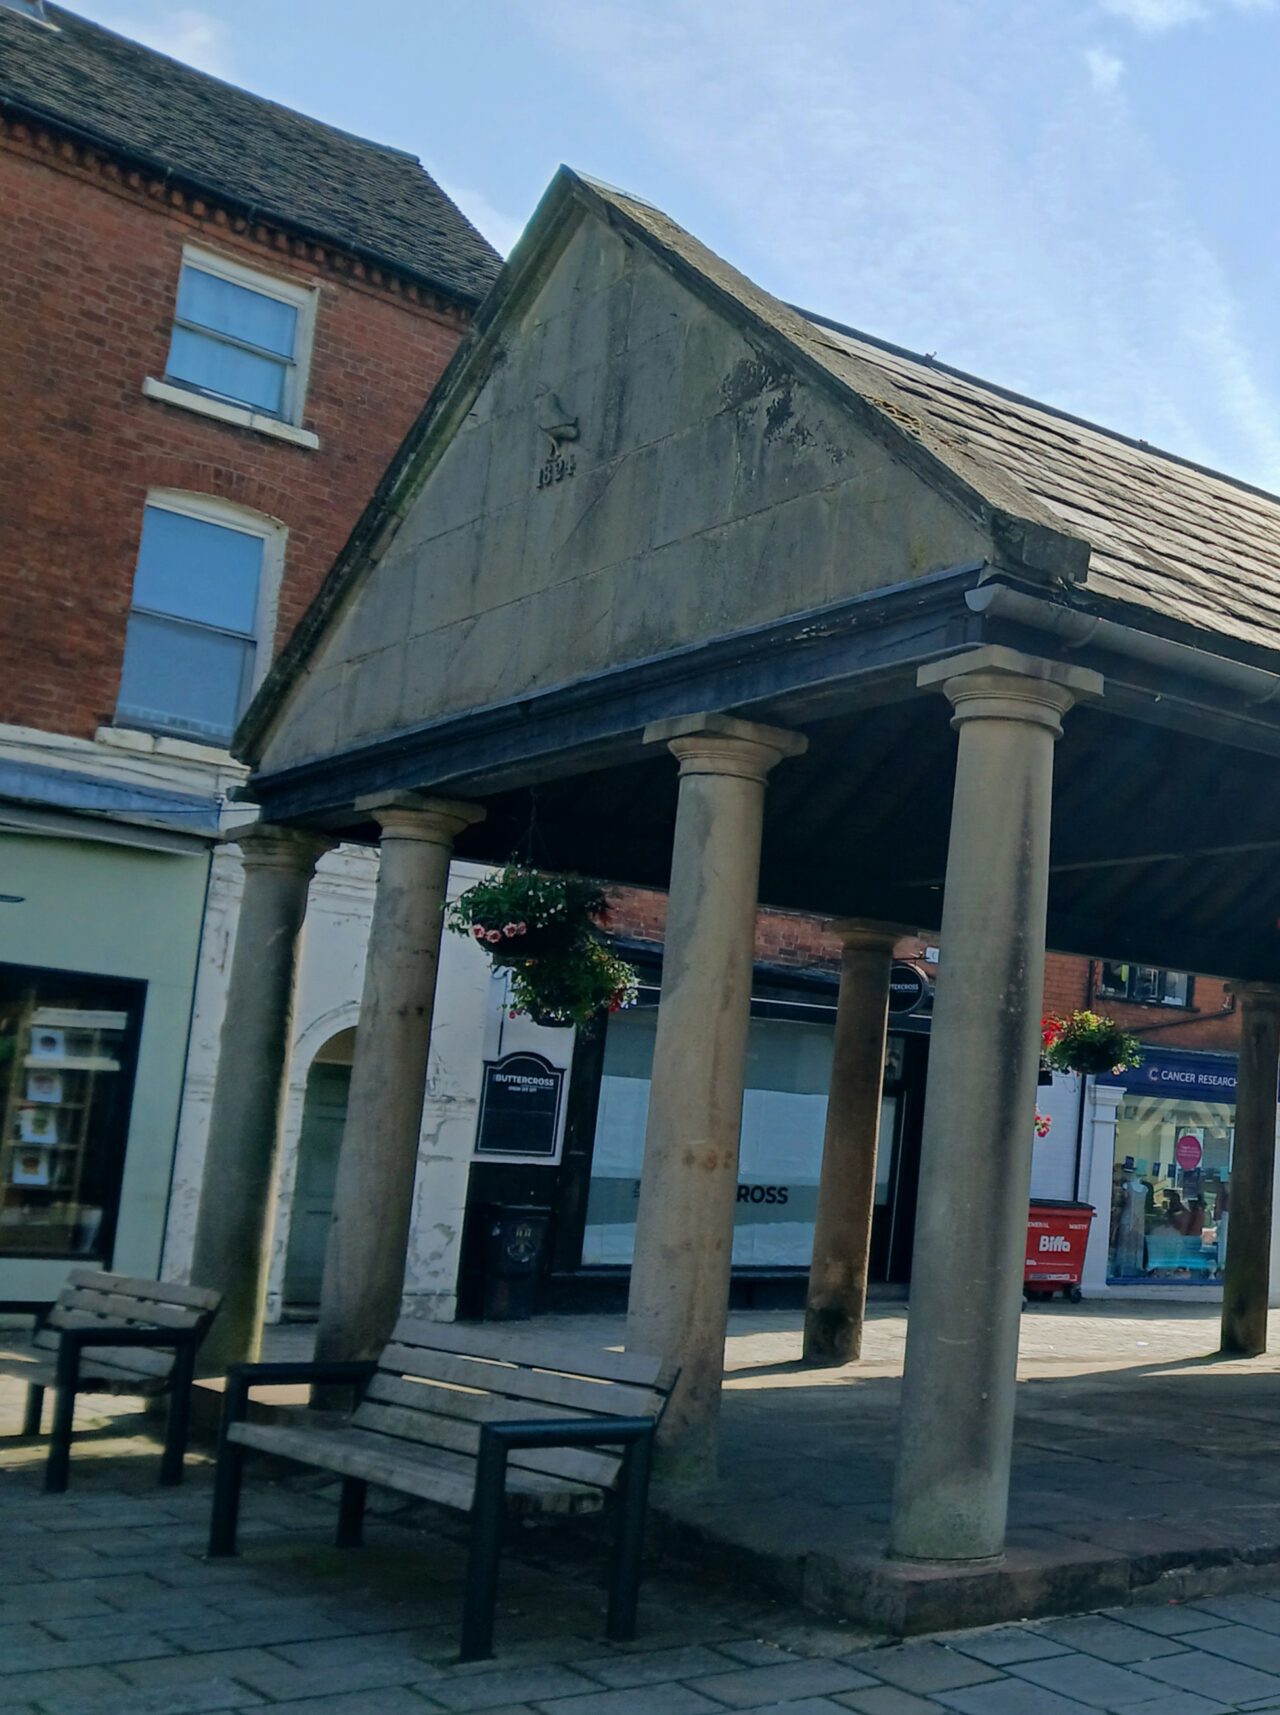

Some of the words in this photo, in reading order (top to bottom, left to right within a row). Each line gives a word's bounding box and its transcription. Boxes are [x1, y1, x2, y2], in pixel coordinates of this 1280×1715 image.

[495, 1073, 555, 1087] BUTTERCROSS
[1161, 1070, 1196, 1083] CANCER
[1039, 1235, 1071, 1252] Biffa
